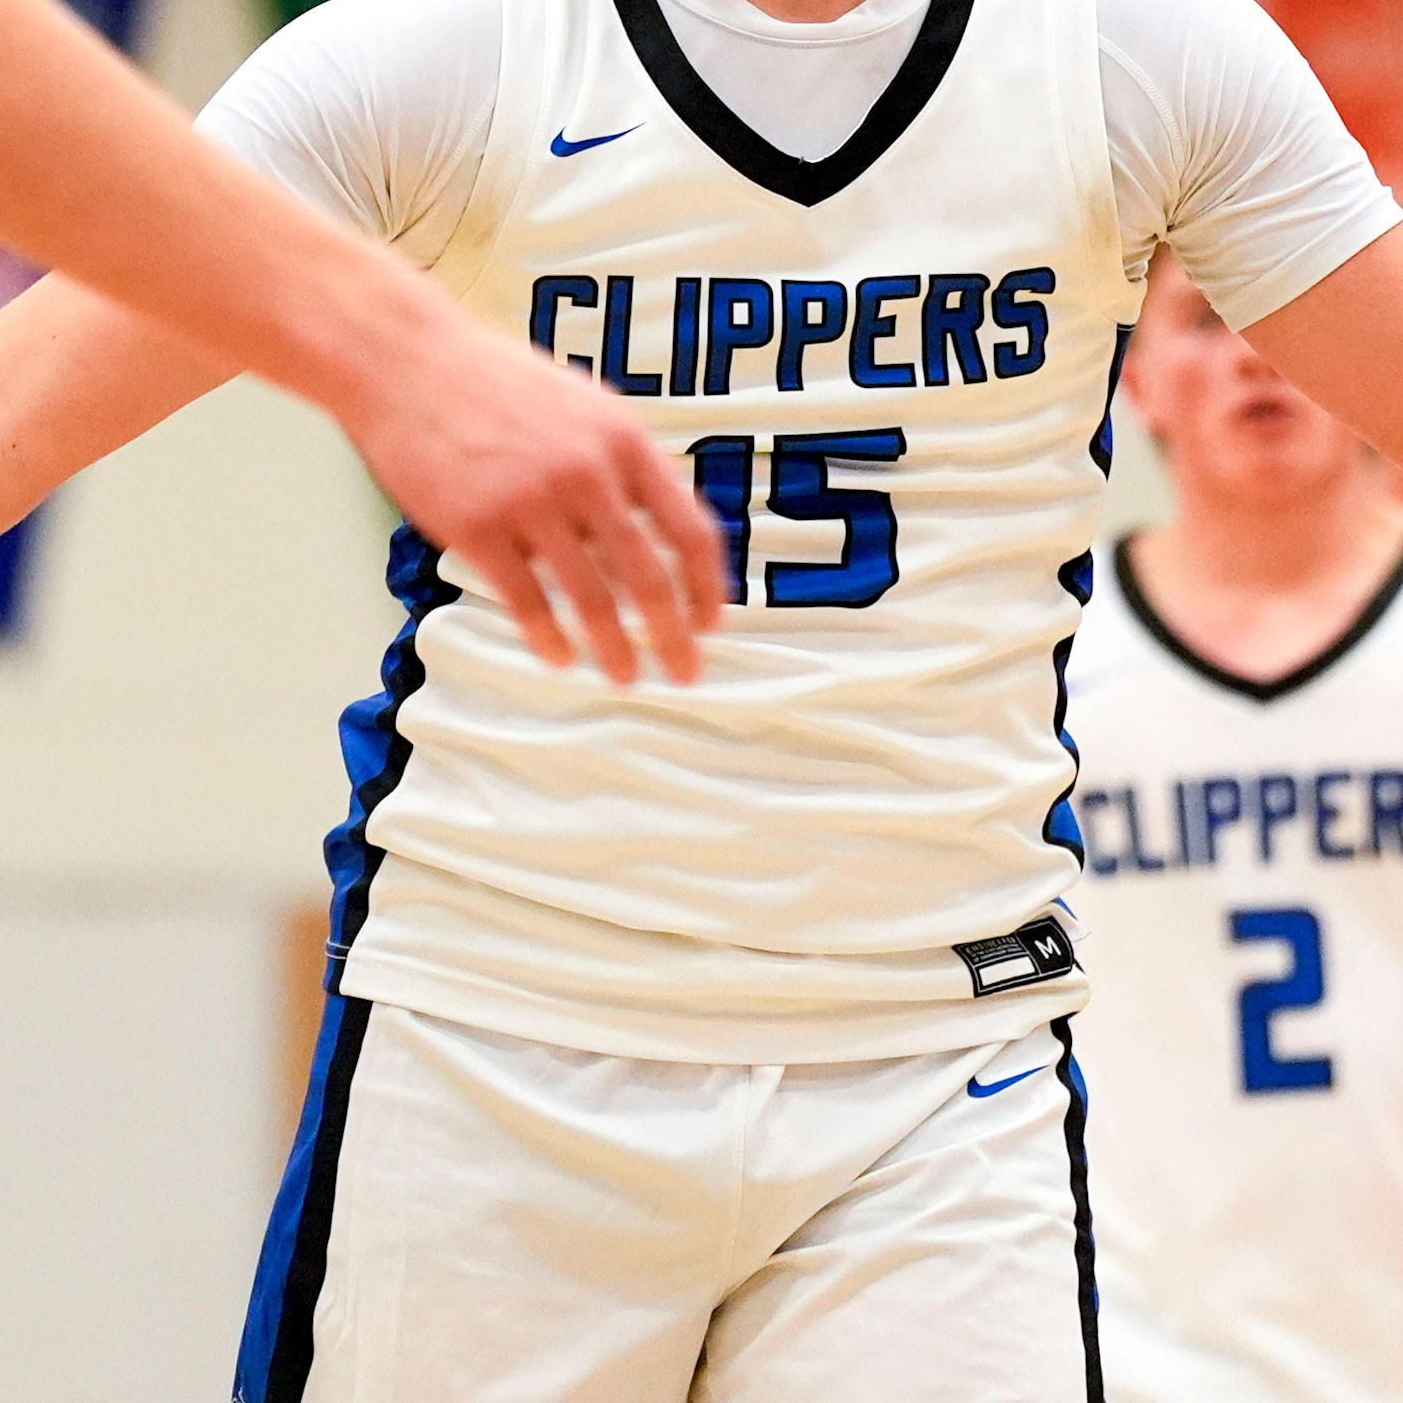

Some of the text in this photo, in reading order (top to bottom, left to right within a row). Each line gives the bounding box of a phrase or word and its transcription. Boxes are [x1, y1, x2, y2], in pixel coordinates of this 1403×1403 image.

[529, 266, 1056, 397] CLIPPERS
[685, 427, 907, 609] 15
[1034, 936, 1061, 959] M
[1227, 906, 1334, 1094] 2
